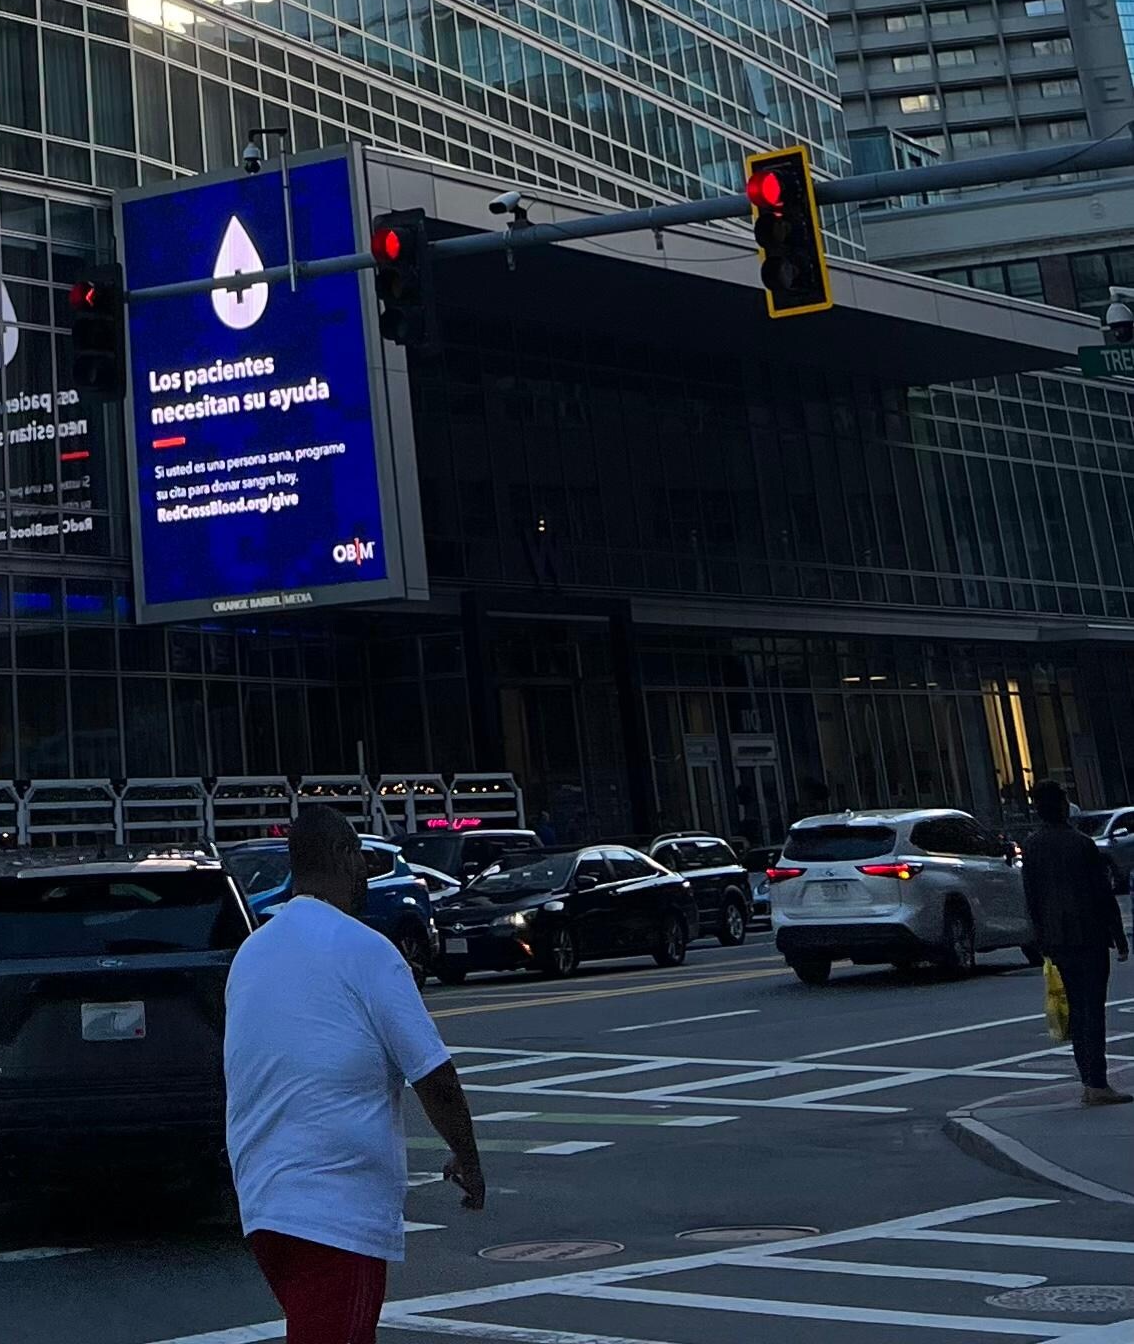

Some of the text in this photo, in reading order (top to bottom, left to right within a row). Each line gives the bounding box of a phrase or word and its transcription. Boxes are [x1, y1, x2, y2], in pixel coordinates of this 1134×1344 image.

[149, 356, 275, 393] Los pacientes
[151, 377, 330, 424] necesitan su ayuda
[154, 442, 346, 479] Si usted es una persona sana, programe
[156, 470, 299, 501] su cita para donar sangre hoy.
[157, 491, 299, 522] RedCrossBlood.org/give
[212, 592, 314, 613] ORANGE BARREL MEDIA
